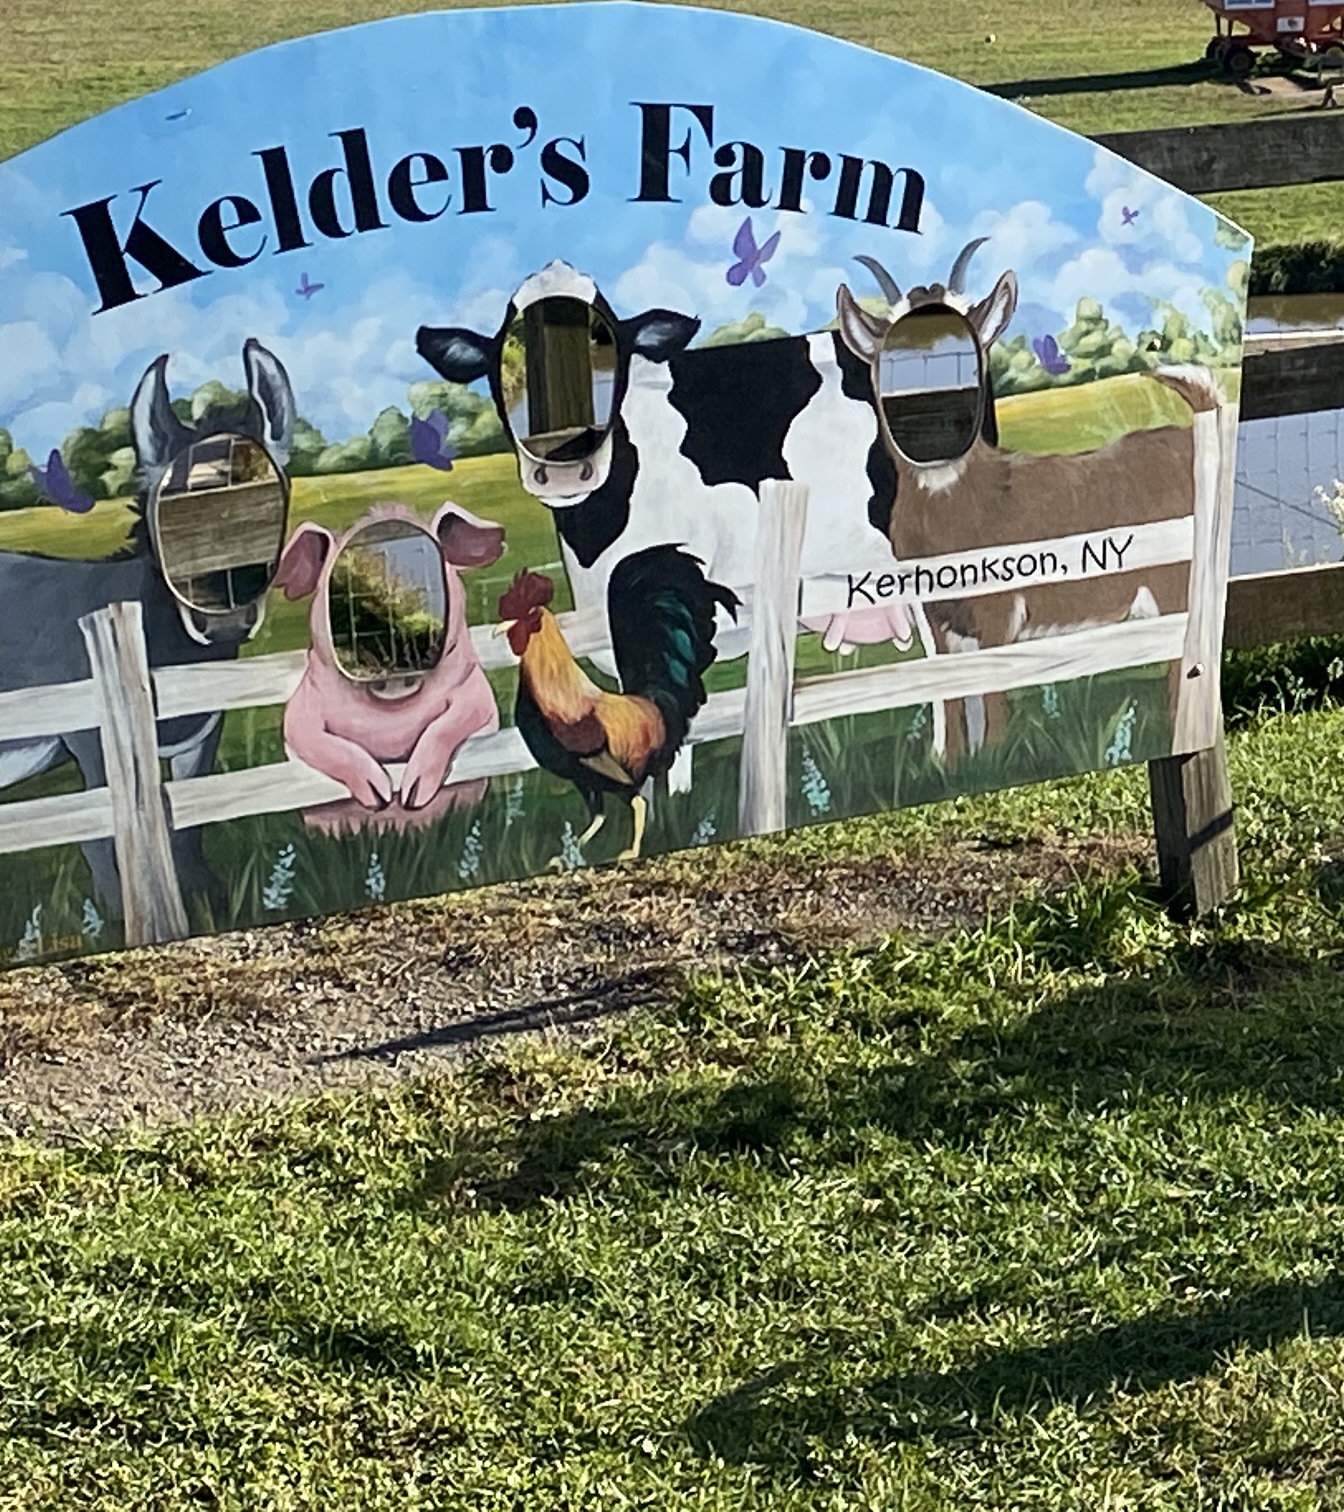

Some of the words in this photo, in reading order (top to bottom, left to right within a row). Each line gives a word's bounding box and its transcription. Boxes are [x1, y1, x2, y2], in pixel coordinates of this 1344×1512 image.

[60, 106, 590, 316] Kelder's
[629, 101, 925, 235] Farm
[846, 551, 1068, 609] Kerhonkson,
[1081, 534, 1134, 574] NY
